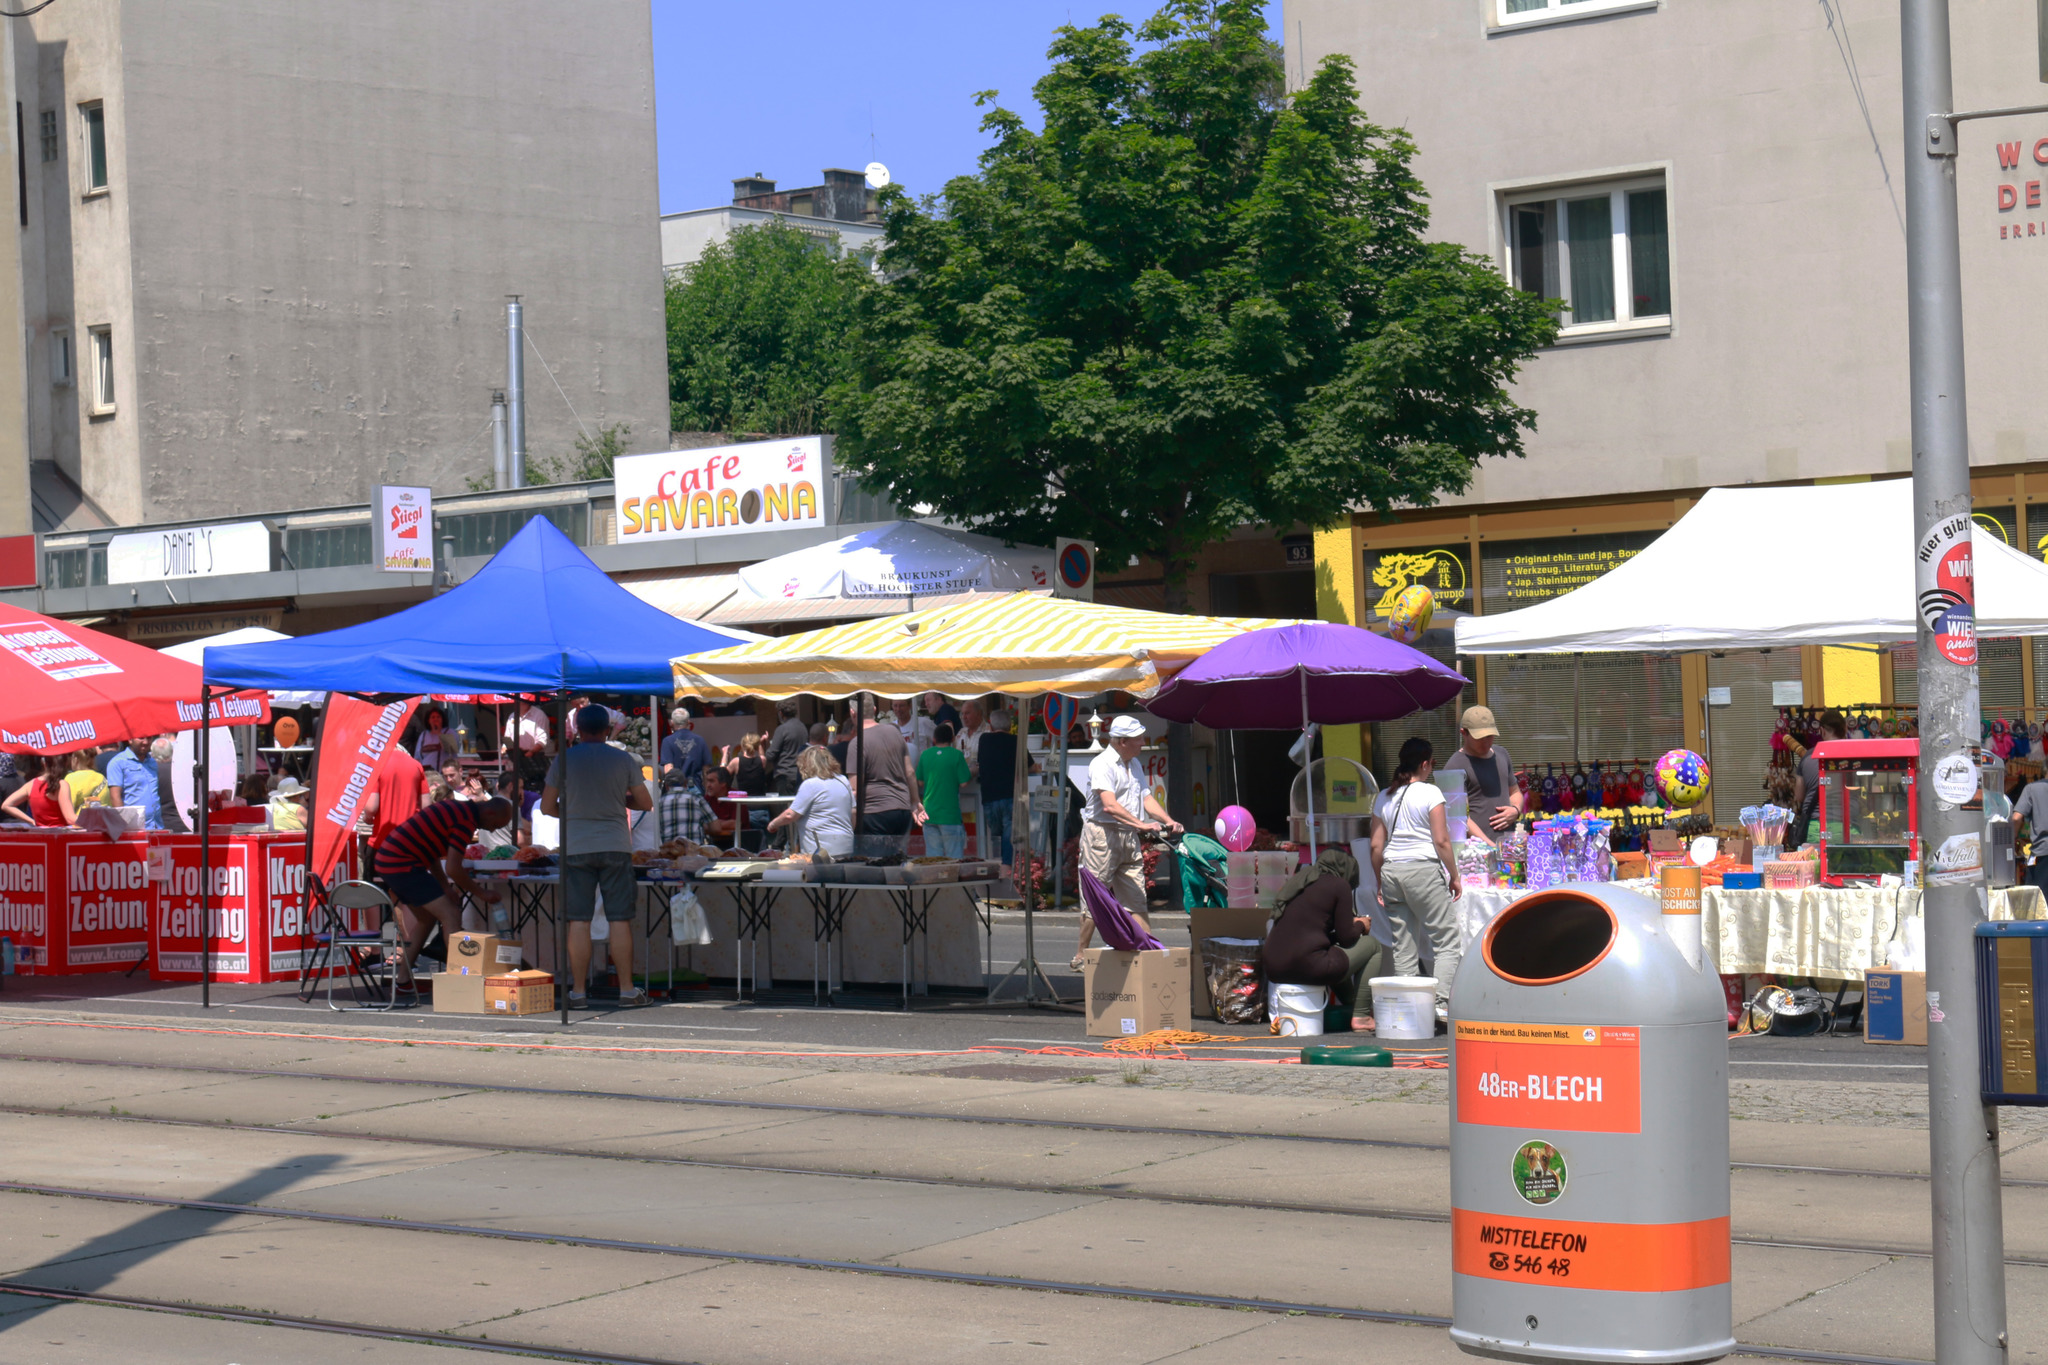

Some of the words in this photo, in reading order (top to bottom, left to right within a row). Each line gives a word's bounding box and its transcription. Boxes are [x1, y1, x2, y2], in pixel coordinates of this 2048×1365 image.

[657, 455, 741, 501] Cafe
[391, 504, 422, 531] Stiegl
[394, 547, 414, 558] Cafe
[1292, 546, 1307, 559] 93
[1919, 533, 1941, 563] Hier
[1514, 554, 1550, 566] Original
[1553, 553, 1576, 563] chin.
[1578, 551, 1595, 561] und
[1598, 550, 1615, 562] jap.
[881, 569, 952, 581] BRAUKUNST
[1515, 565, 1561, 576] Werkzeug,
[1564, 563, 1606, 573] Literatur,
[852, 583, 874, 593] AUF
[946, 578, 981, 588] STUFE
[1515, 578, 1534, 588] Jap.
[1434, 590, 1465, 599] STUDIO
[1515, 587, 1554, 598] Urlaubs-
[220, 695, 262, 718] Zeitung
[45, 719, 97, 746] Zeitung
[326, 762, 374, 827] Kronen
[358, 700, 408, 761] Zeitung
[1683, 887, 1696, 898] AN
[1870, 980, 1888, 988] TORK
[1091, 991, 1136, 1002] sodastream
[1457, 1026, 1464, 1034] Du
[1464, 1026, 1476, 1034] hast
[1490, 1027, 1499, 1036] der
[1500, 1028, 1516, 1037] Hand.
[1517, 1029, 1529, 1037] Bau
[1530, 1029, 1552, 1038] keinen
[1554, 1030, 1570, 1039] Mist.
[1480, 1225, 1587, 1253] MISTTELEFON
[1513, 1254, 1542, 1275] 546
[1547, 1258, 1571, 1277] 48
